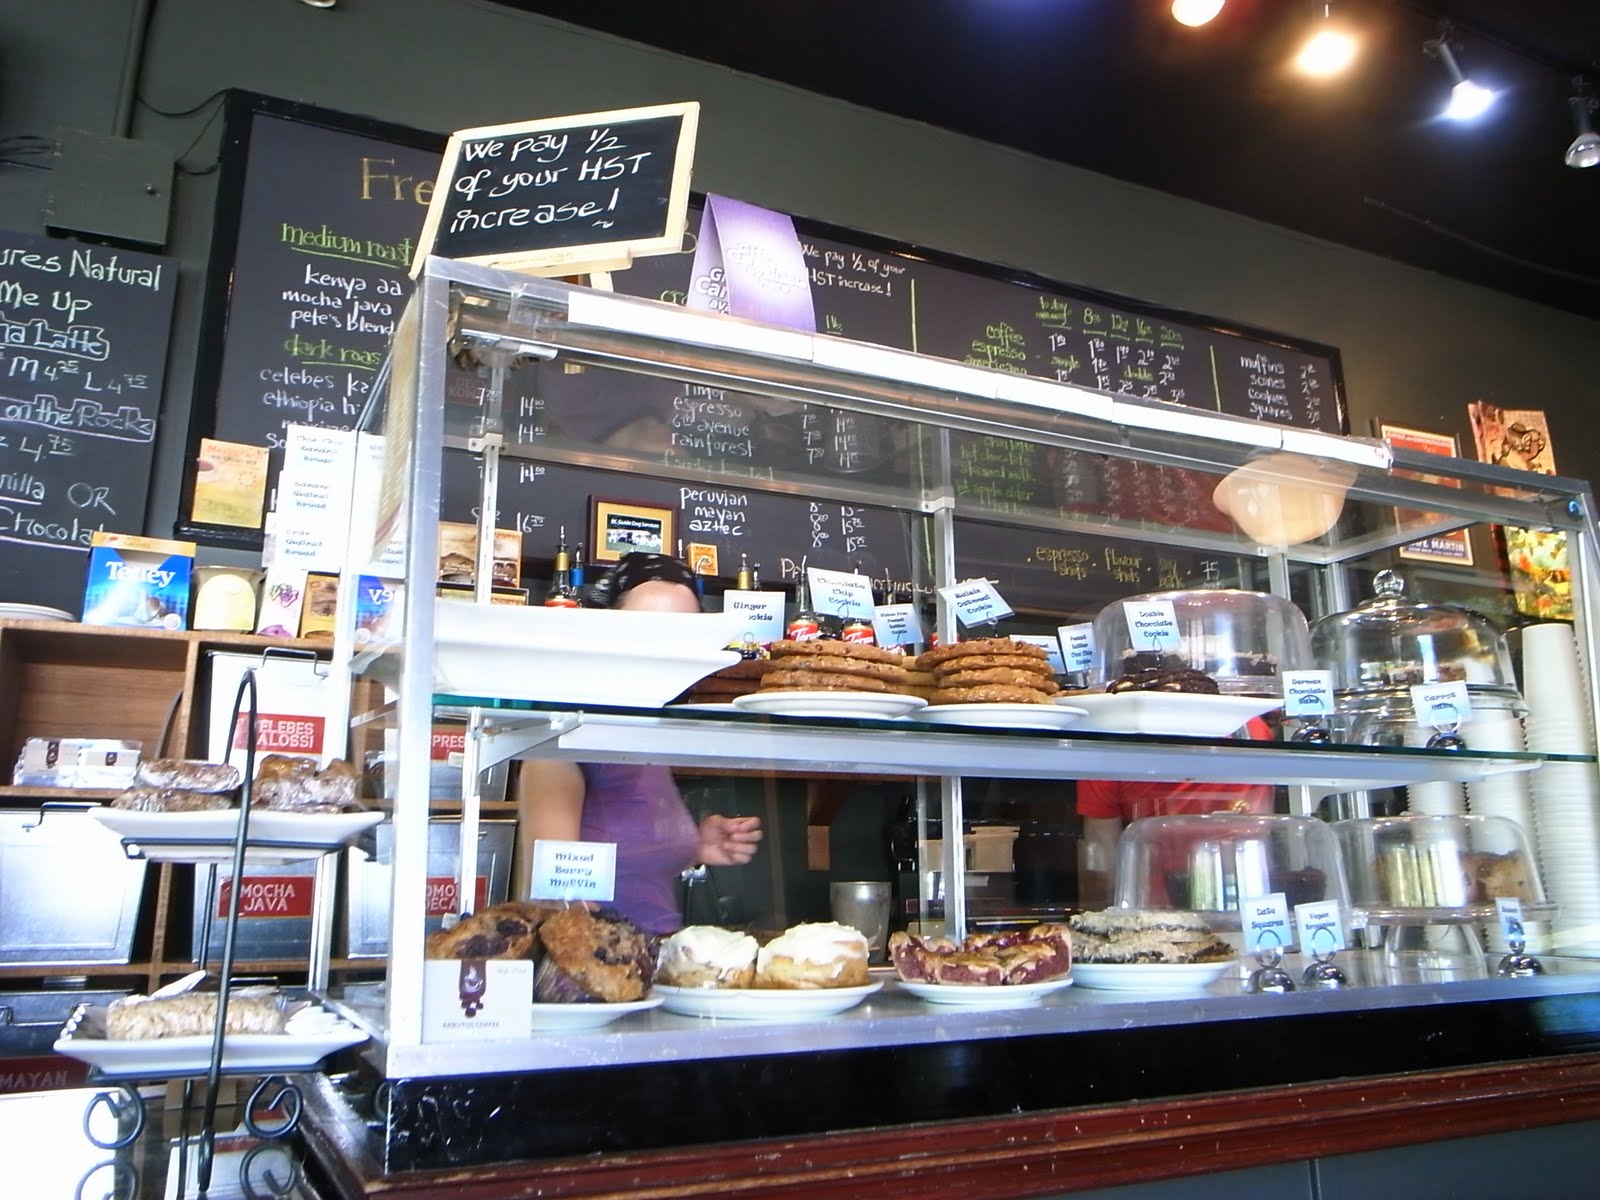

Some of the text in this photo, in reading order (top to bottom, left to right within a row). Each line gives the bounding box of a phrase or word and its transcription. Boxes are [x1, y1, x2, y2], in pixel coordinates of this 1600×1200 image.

[465, 142, 505, 162] We
[511, 135, 568, 163] pay
[455, 152, 652, 201] of your HST
[281, 222, 413, 267] medium roast
[69, 249, 162, 291] Natural
[803, 243, 820, 258] We
[825, 251, 845, 270] pay
[868, 258, 880, 274] of
[880, 264, 906, 279] your
[304, 264, 403, 299] kenya aa
[838, 275, 884, 294] increase
[51, 291, 93, 324] Up
[282, 290, 393, 323] mocha java
[290, 308, 396, 335] pete's blend
[34, 322, 103, 355] Latte
[284, 333, 333, 358] dark
[986, 321, 1026, 350] coffee
[972, 339, 1026, 367] espresso
[1240, 353, 1285, 375] muffins
[84, 371, 103, 391] L
[260, 366, 335, 389] celebes
[1249, 374, 1286, 389] scones
[5, 404, 32, 420] on
[36, 398, 73, 426] the
[263, 389, 335, 423] ethiopia
[673, 396, 742, 423] espresso
[697, 419, 750, 438] avenue
[671, 431, 753, 458] rainforest
[67, 482, 117, 516] OR
[680, 487, 748, 510] peruvian
[688, 519, 743, 536] aztec
[694, 506, 746, 525] mayan
[1036, 546, 1090, 572] espresso
[105, 560, 177, 590] Teey
[832, 588, 854, 598] Chip
[733, 601, 767, 611] Ginger
[748, 613, 774, 622] okie
[1134, 620, 1174, 628] Chocolate
[255, 720, 314, 735] ELEBES
[255, 734, 314, 748] ALOSSI
[554, 865, 592, 877] Berry
[240, 884, 295, 898] MOCHA
[244, 898, 288, 912] JAVA
[0, 1071, 68, 1089] MAYAN
